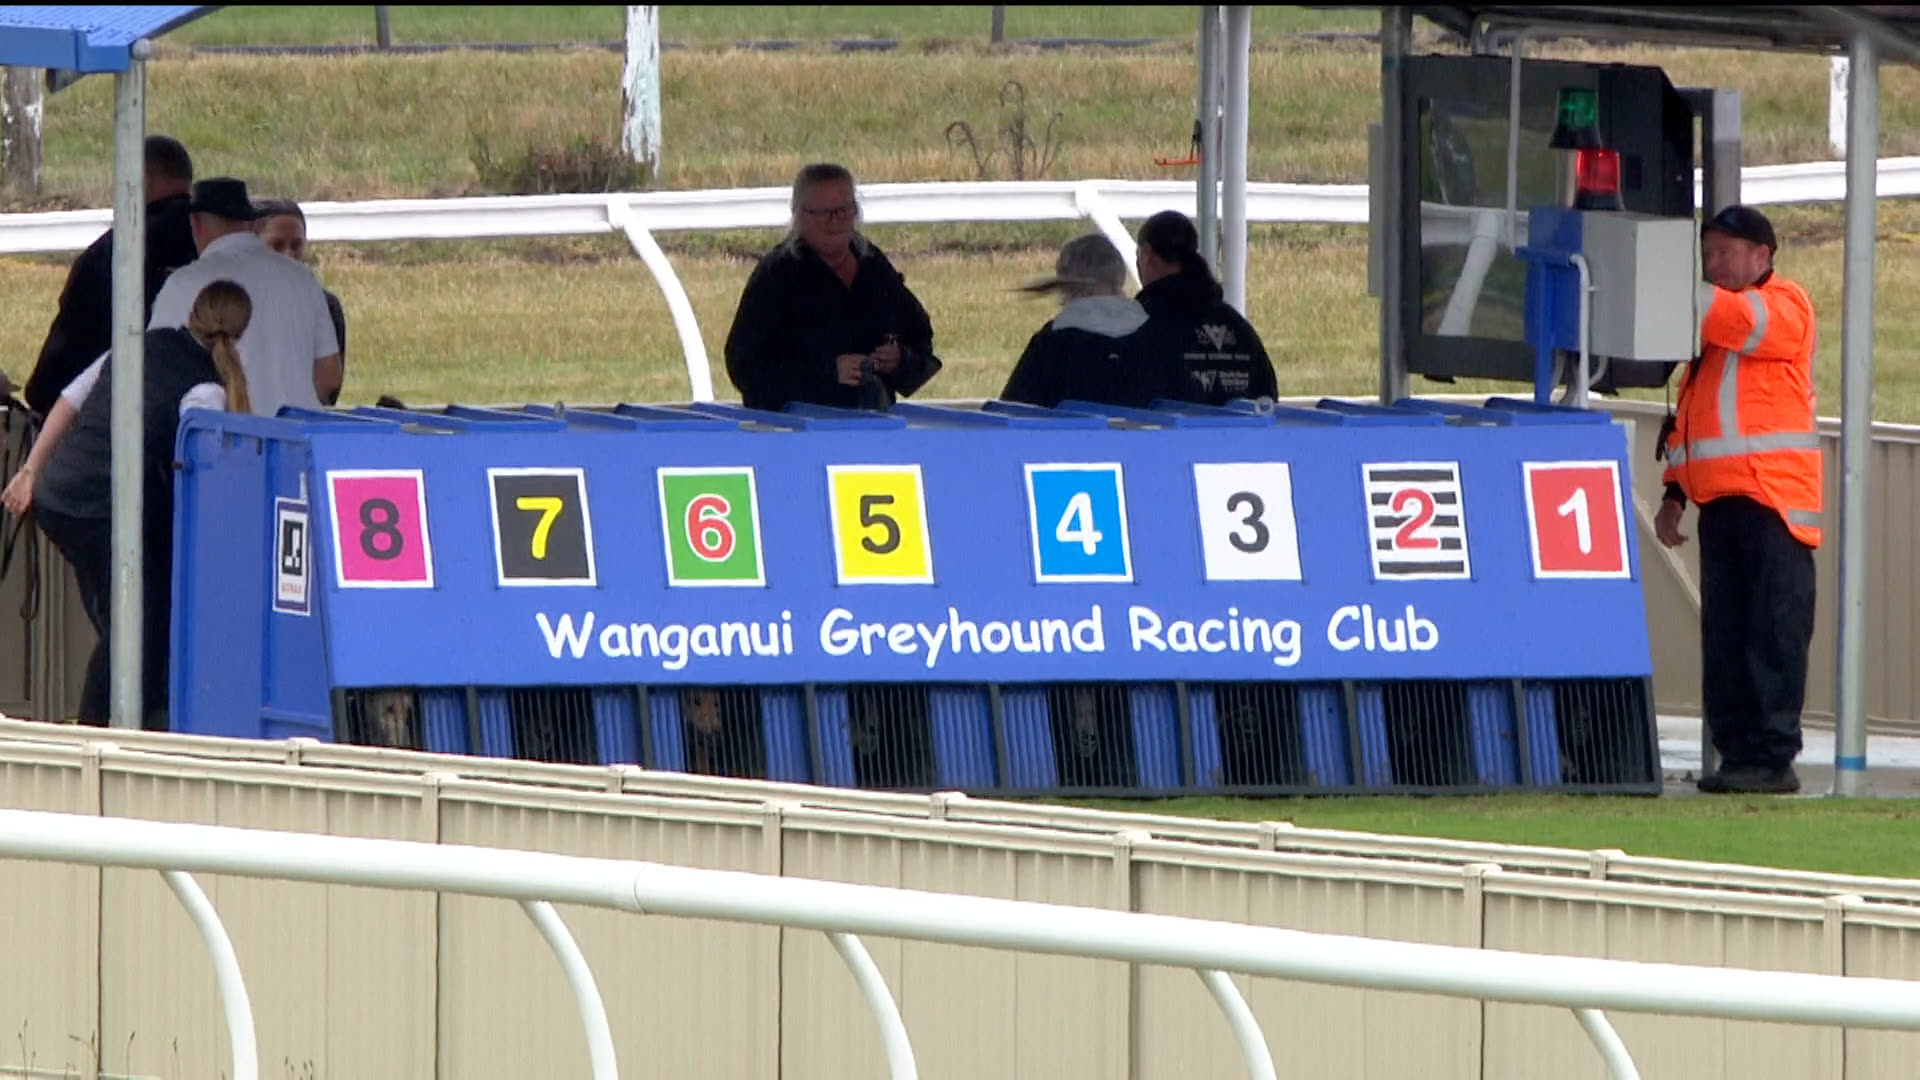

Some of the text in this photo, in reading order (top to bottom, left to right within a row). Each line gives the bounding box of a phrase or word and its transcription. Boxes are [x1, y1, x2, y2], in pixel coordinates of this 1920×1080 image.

[359, 498, 403, 560] 8
[516, 497, 563, 559] 7
[684, 493, 735, 562] 6
[860, 495, 901, 554] 5
[1055, 492, 1103, 555] 4
[1227, 492, 1270, 553] 3
[1391, 488, 1440, 550] 2
[1557, 487, 1593, 555] 1
[536, 604, 1439, 670] Wanganui Greyhound Racing Club
